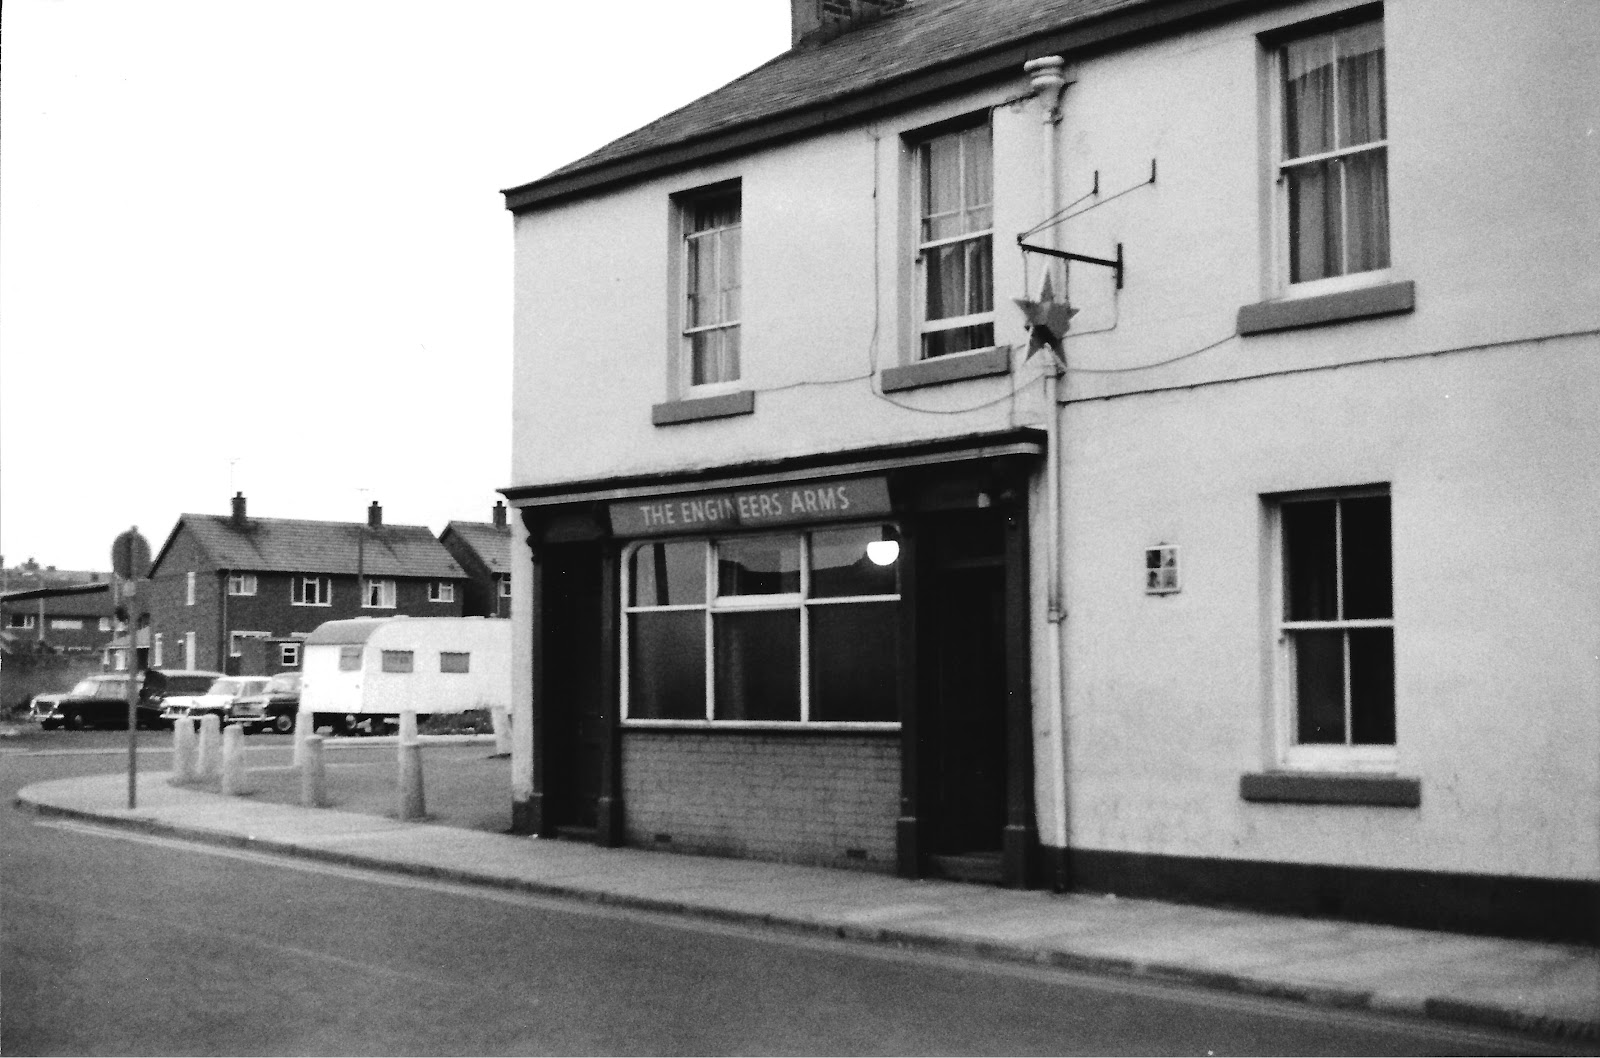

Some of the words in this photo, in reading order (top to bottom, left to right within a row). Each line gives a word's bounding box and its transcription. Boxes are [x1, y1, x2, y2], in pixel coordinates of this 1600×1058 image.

[639, 503, 676, 527] THE
[681, 493, 783, 524] ENGINEERS
[790, 486, 850, 514] ARMS
